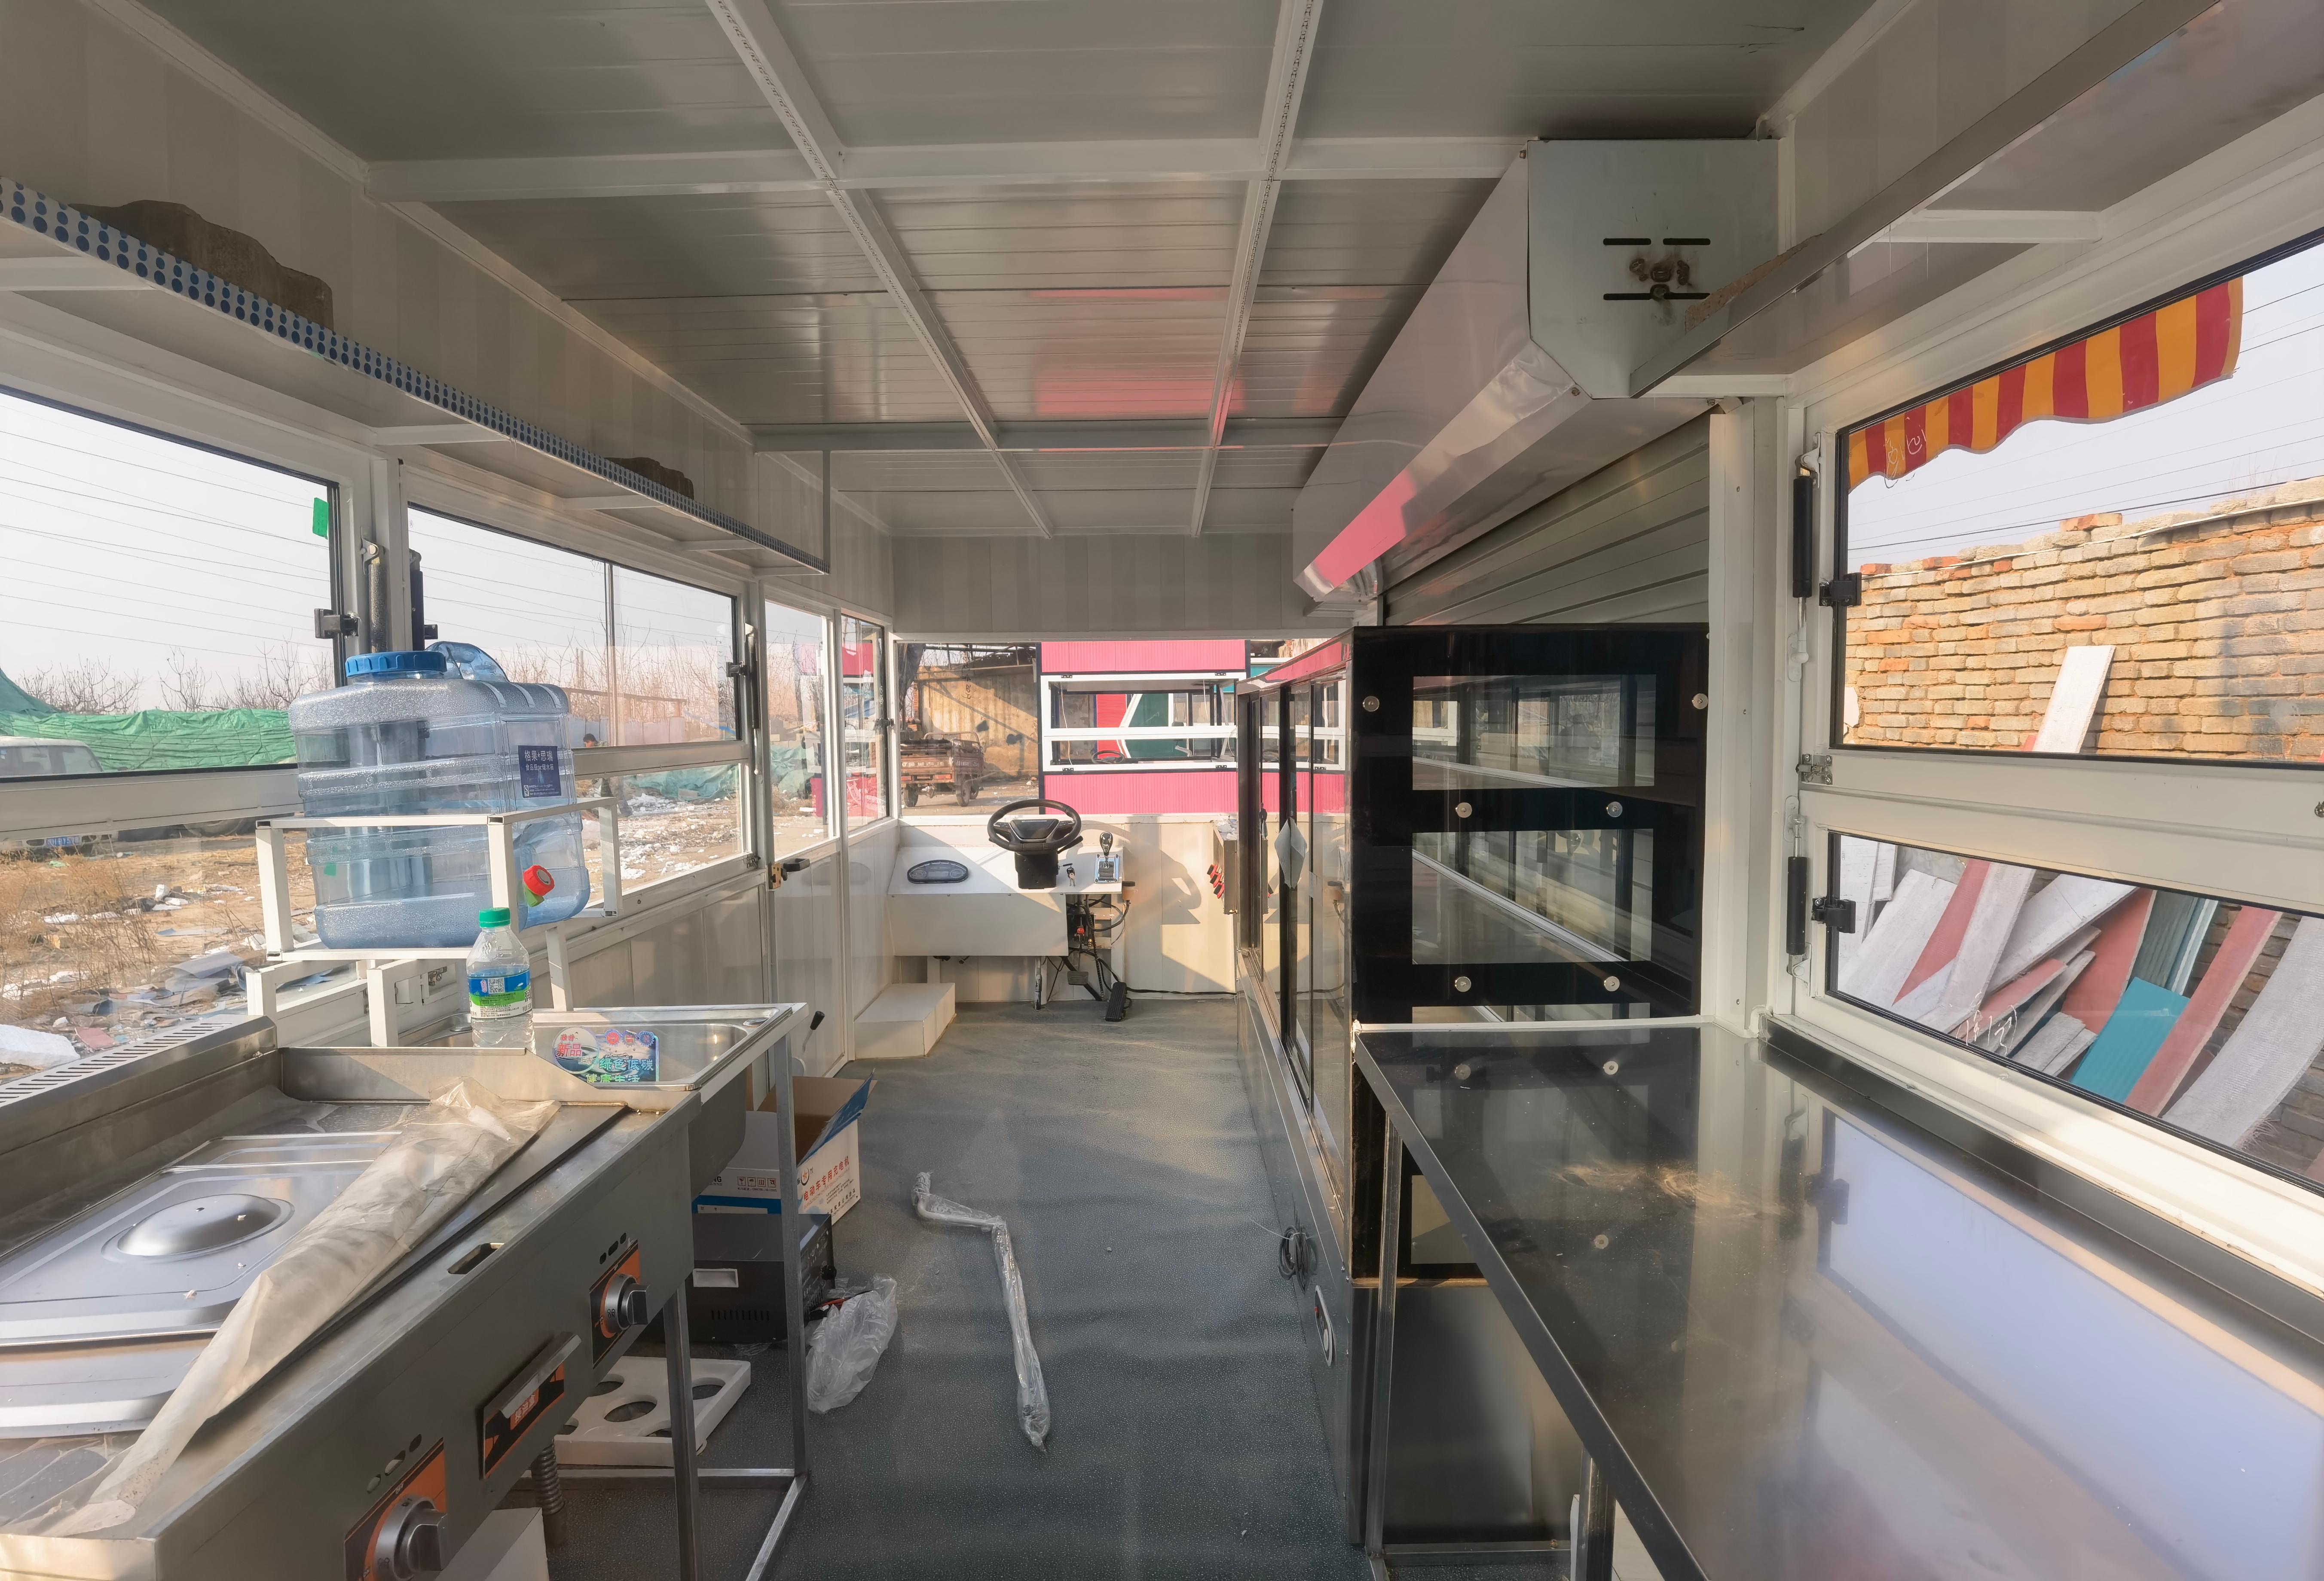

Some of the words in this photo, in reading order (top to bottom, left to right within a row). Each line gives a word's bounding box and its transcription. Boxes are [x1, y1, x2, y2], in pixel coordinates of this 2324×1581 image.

[557, 1043, 582, 1057] 新品
[599, 1058, 654, 1071] 绿色低碳
[804, 1156, 850, 1201] 电动车专用充电机
